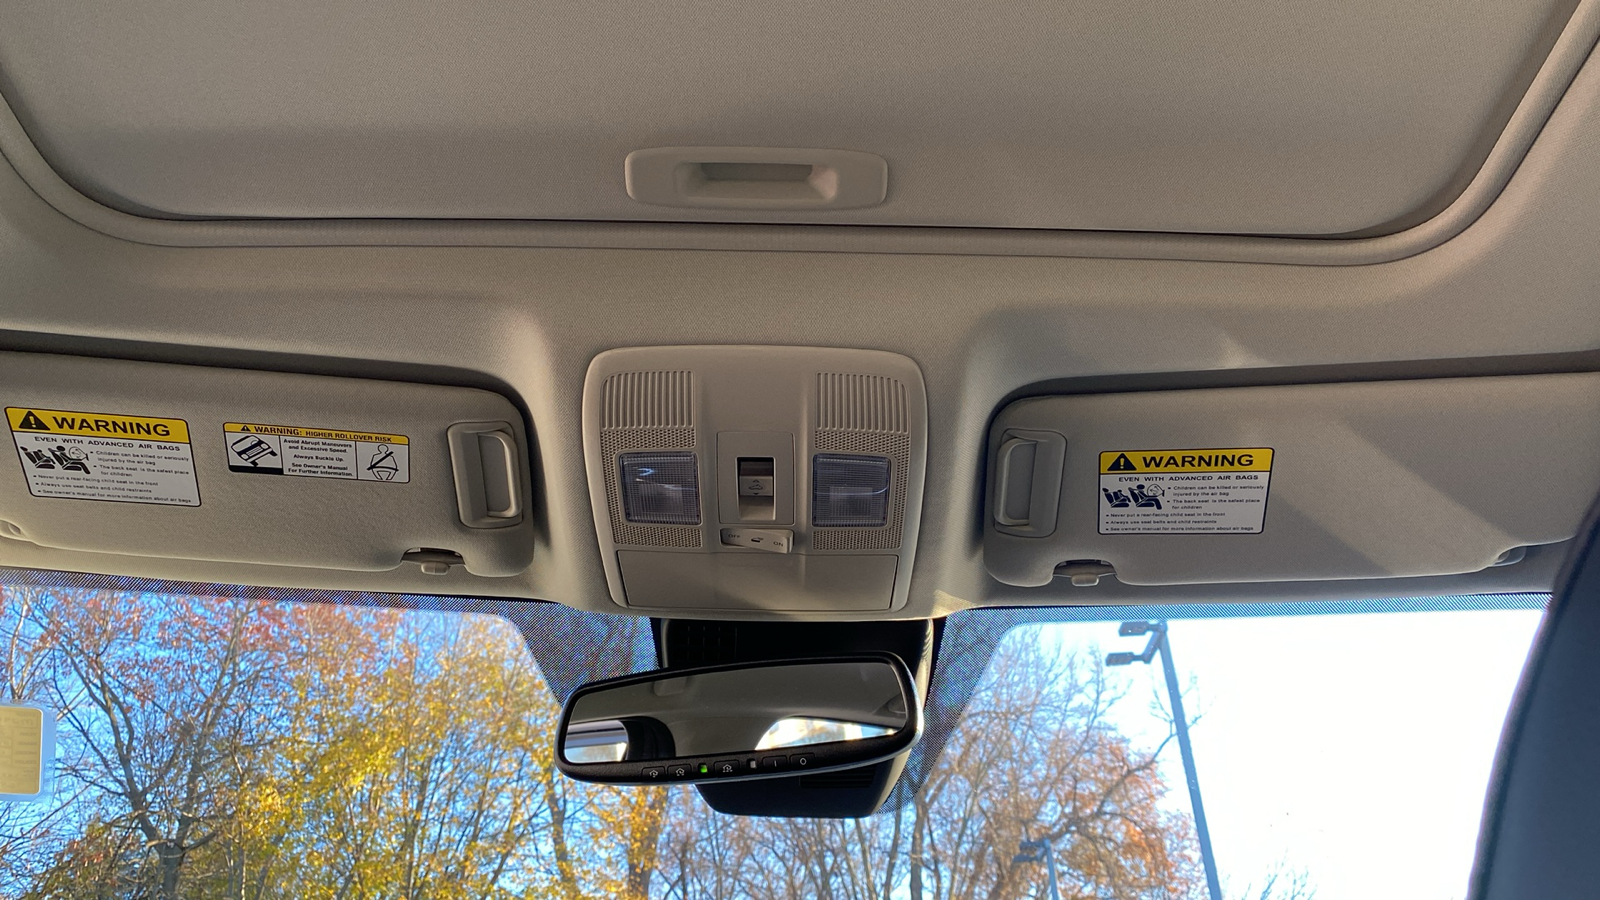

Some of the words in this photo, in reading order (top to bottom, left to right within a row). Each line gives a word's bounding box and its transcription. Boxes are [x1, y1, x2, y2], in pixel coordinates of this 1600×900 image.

[52, 416, 170, 436] WARNING
[254, 426, 302, 435] WARNING:
[335, 432, 373, 441] ROLLOVER
[1142, 454, 1254, 468] WARNING
